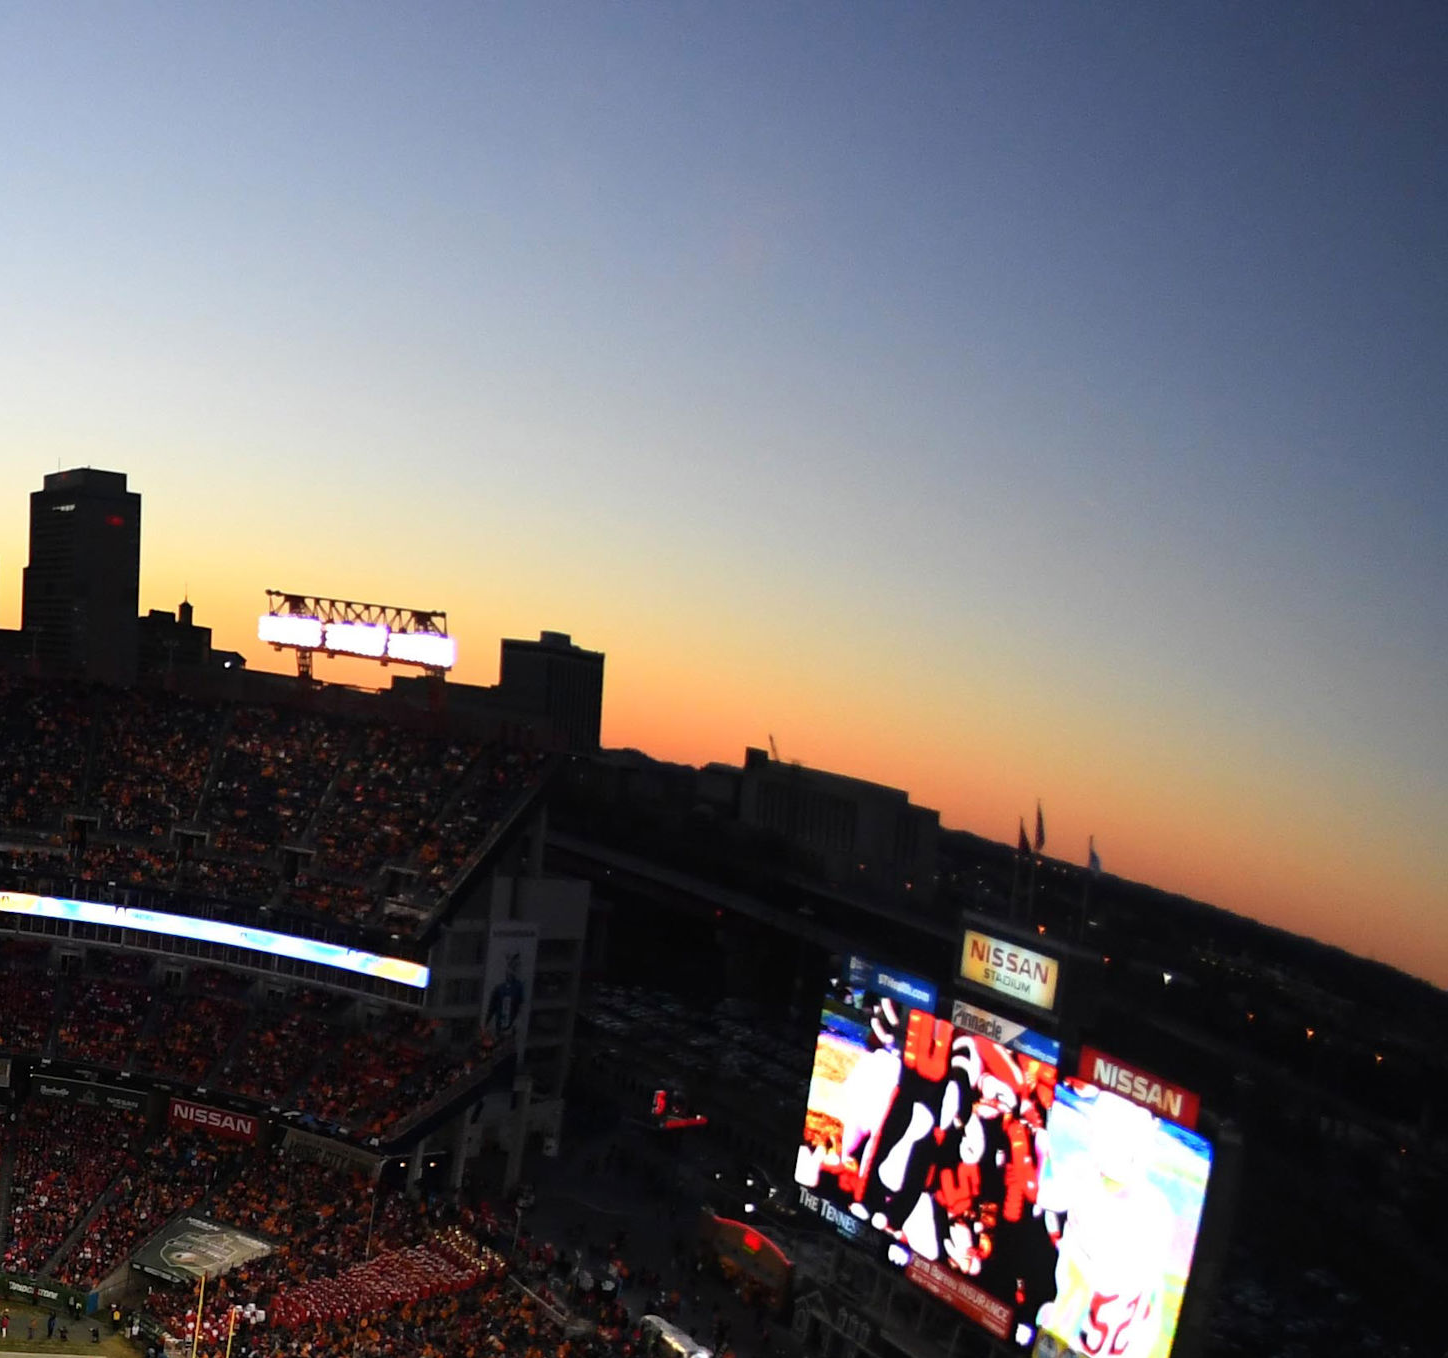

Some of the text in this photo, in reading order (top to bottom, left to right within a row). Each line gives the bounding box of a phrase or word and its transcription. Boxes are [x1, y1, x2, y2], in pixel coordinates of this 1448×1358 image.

[970, 938, 1049, 985] NISSAN
[983, 968, 1031, 995] STADIUM
[953, 1006, 1004, 1043] Pinnacle
[1093, 1057, 1183, 1118] NISSAN
[172, 1102, 253, 1135] NISSAN
[800, 1186, 819, 1212] THE
